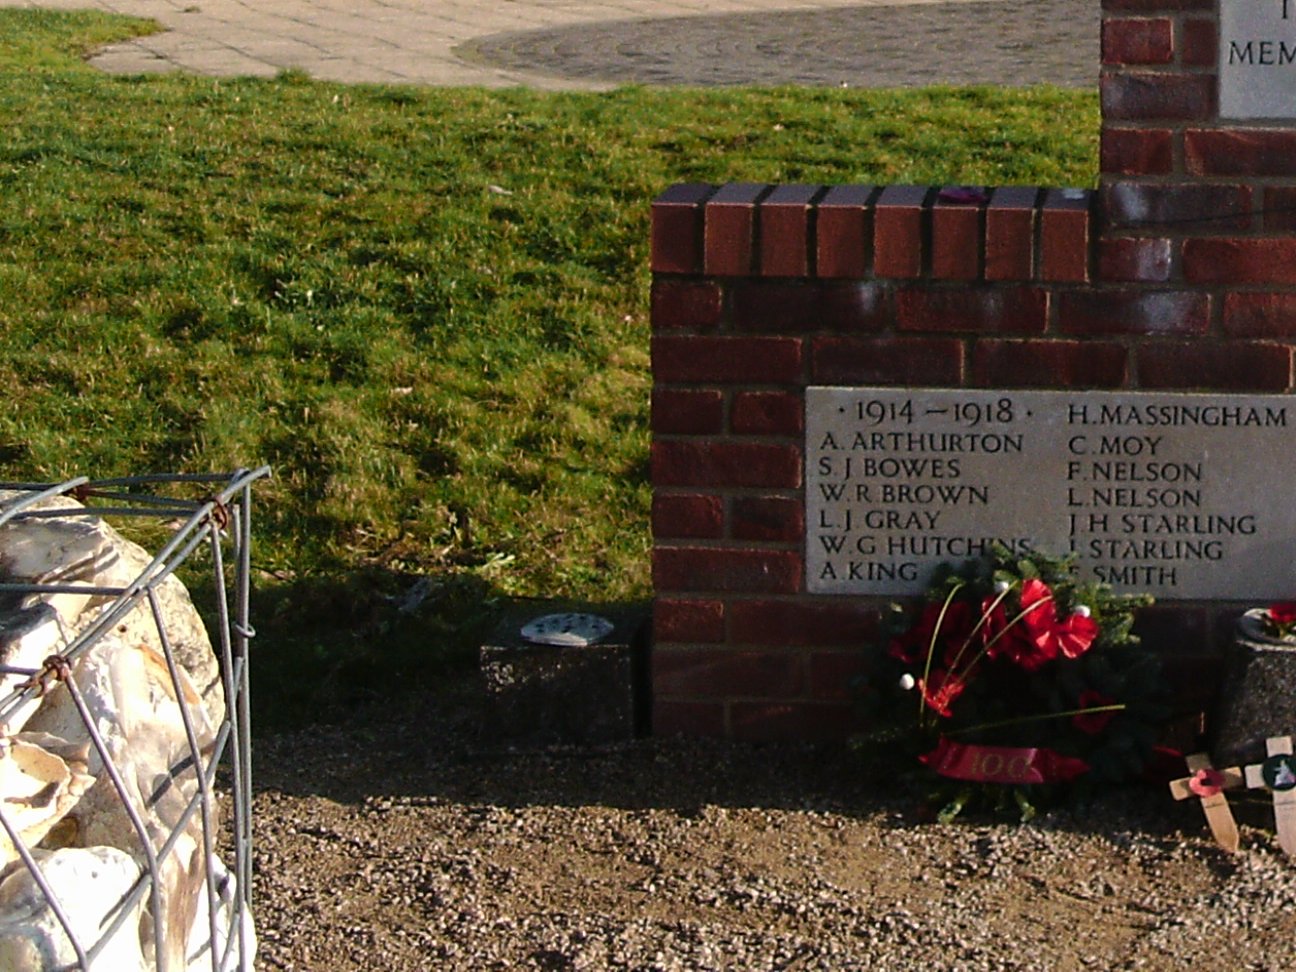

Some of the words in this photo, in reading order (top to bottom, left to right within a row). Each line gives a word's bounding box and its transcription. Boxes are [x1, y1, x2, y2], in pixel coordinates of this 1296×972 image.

[865, 457, 961, 479] BOWES
[865, 509, 941, 529] GRAY
[1121, 514, 1257, 536] STARLING
[1093, 565, 1177, 586] SMITH
